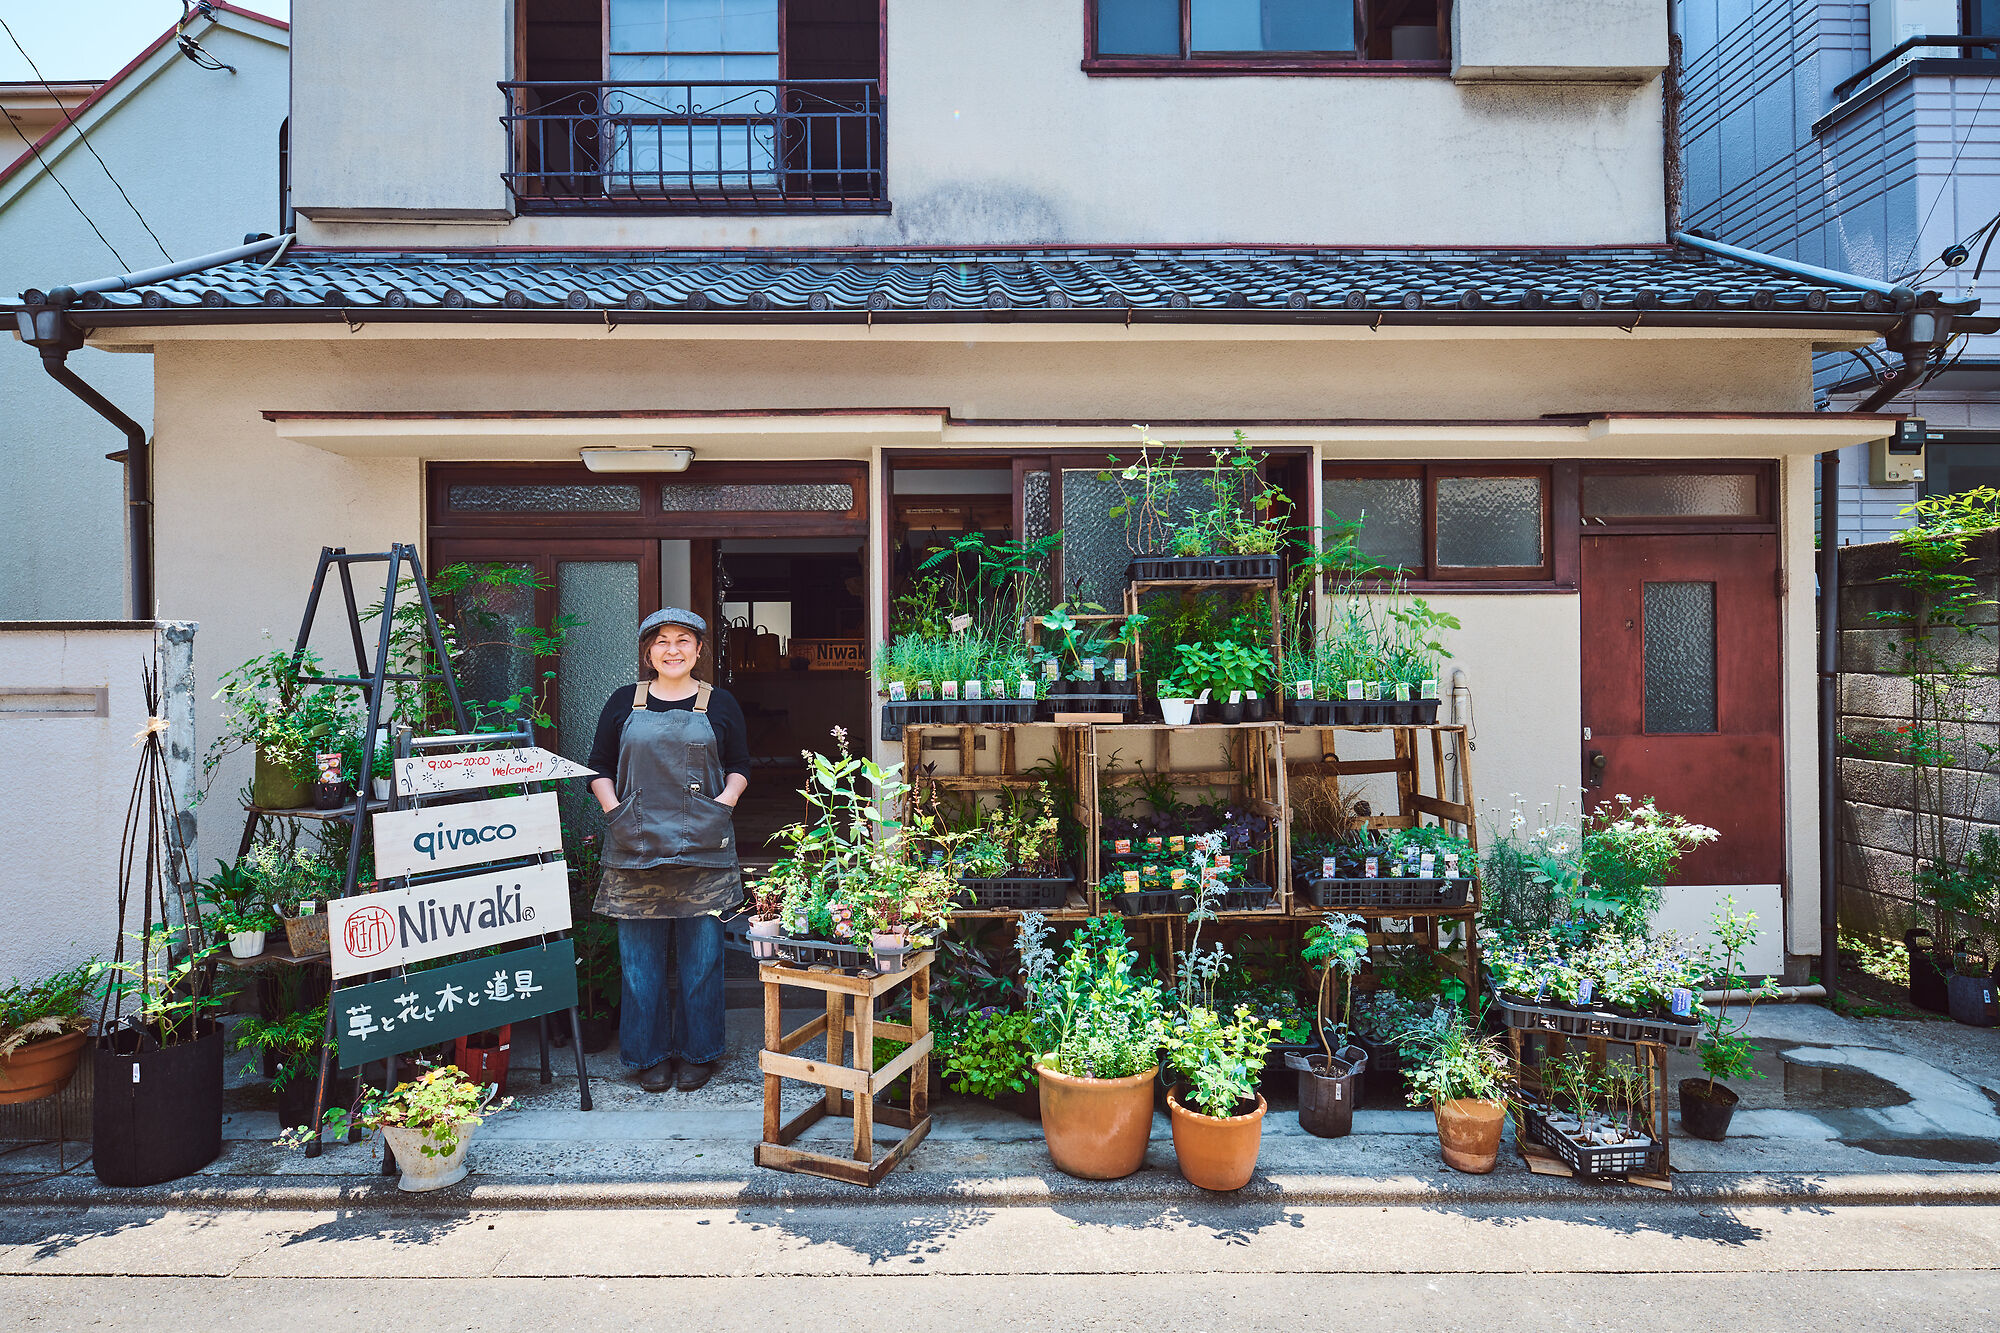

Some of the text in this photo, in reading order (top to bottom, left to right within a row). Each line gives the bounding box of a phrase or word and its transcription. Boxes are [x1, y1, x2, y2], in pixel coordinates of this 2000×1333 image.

[491, 762, 543, 776] Welcome!!
[413, 821, 517, 861] qivaco
[346, 969, 543, 1042] 草と花と木と道具
